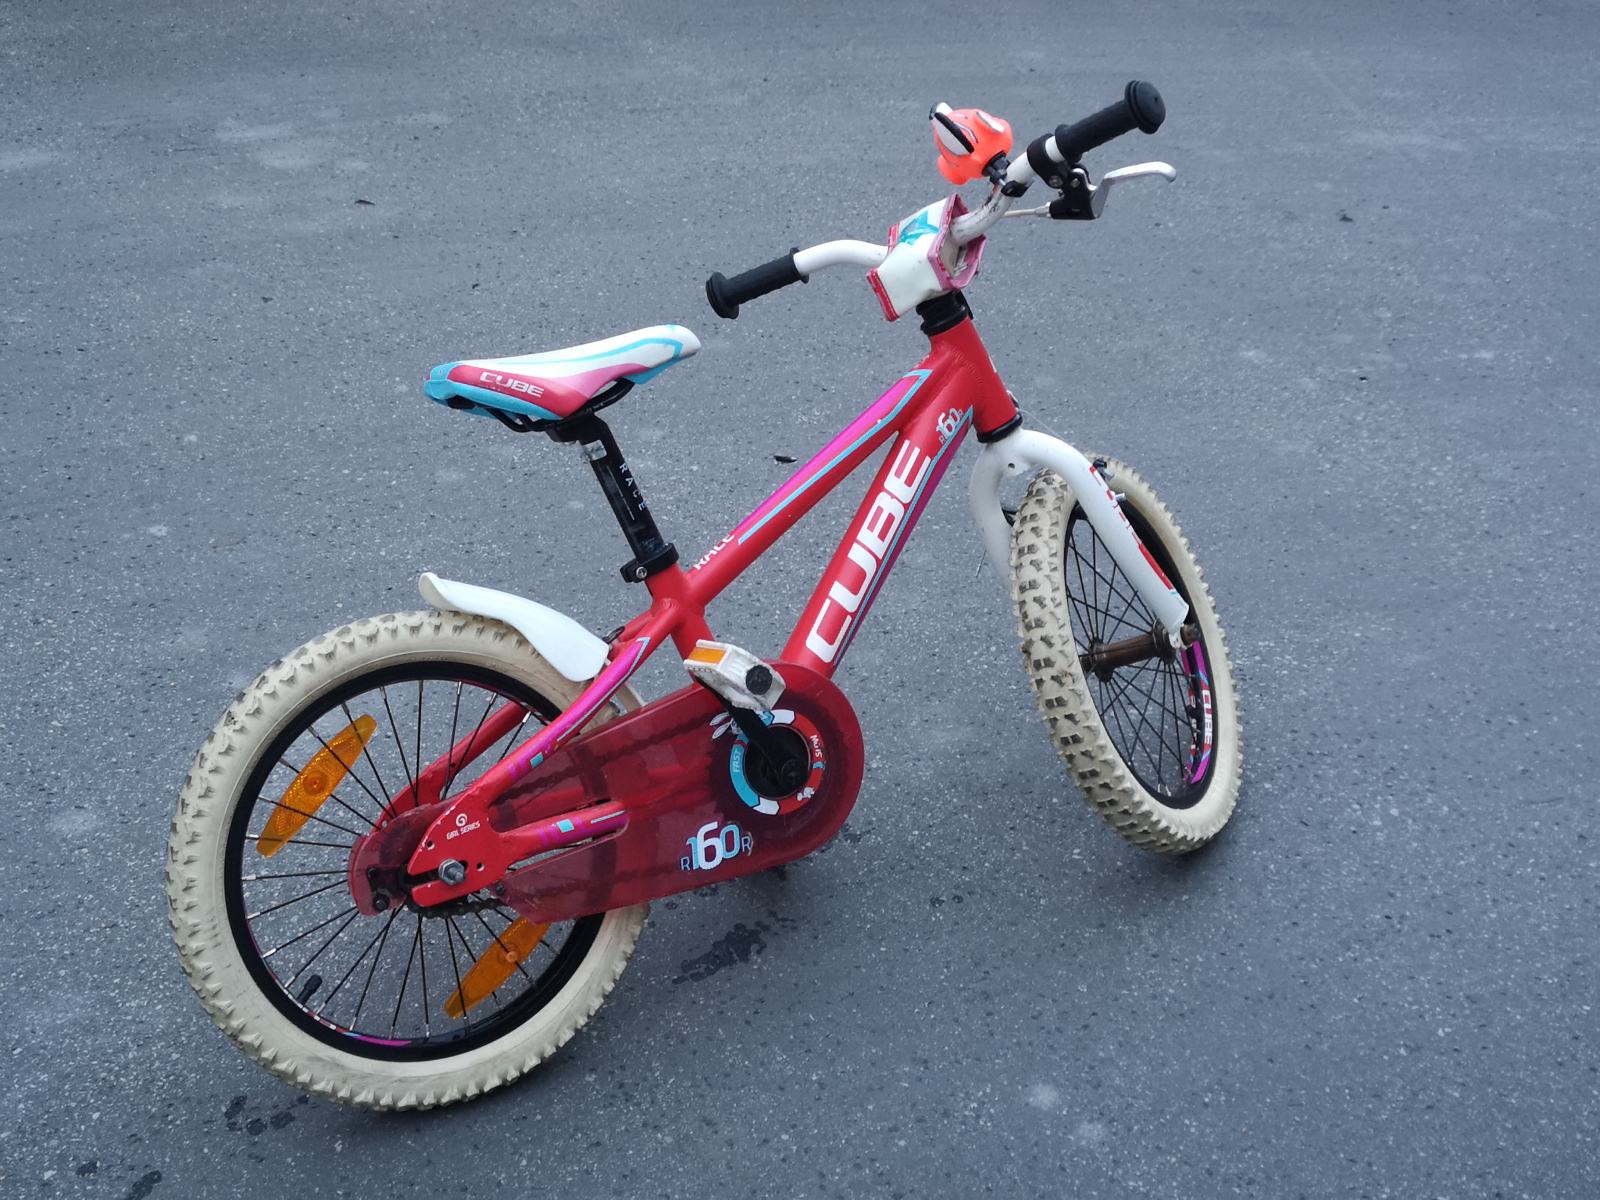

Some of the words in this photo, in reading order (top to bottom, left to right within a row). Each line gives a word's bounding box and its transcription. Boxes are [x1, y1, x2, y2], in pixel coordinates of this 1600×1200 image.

[480, 372, 544, 398] CUBE
[620, 464, 647, 511] RACE
[806, 439, 932, 663] CUBE
[1202, 689, 1213, 744] CUBE
